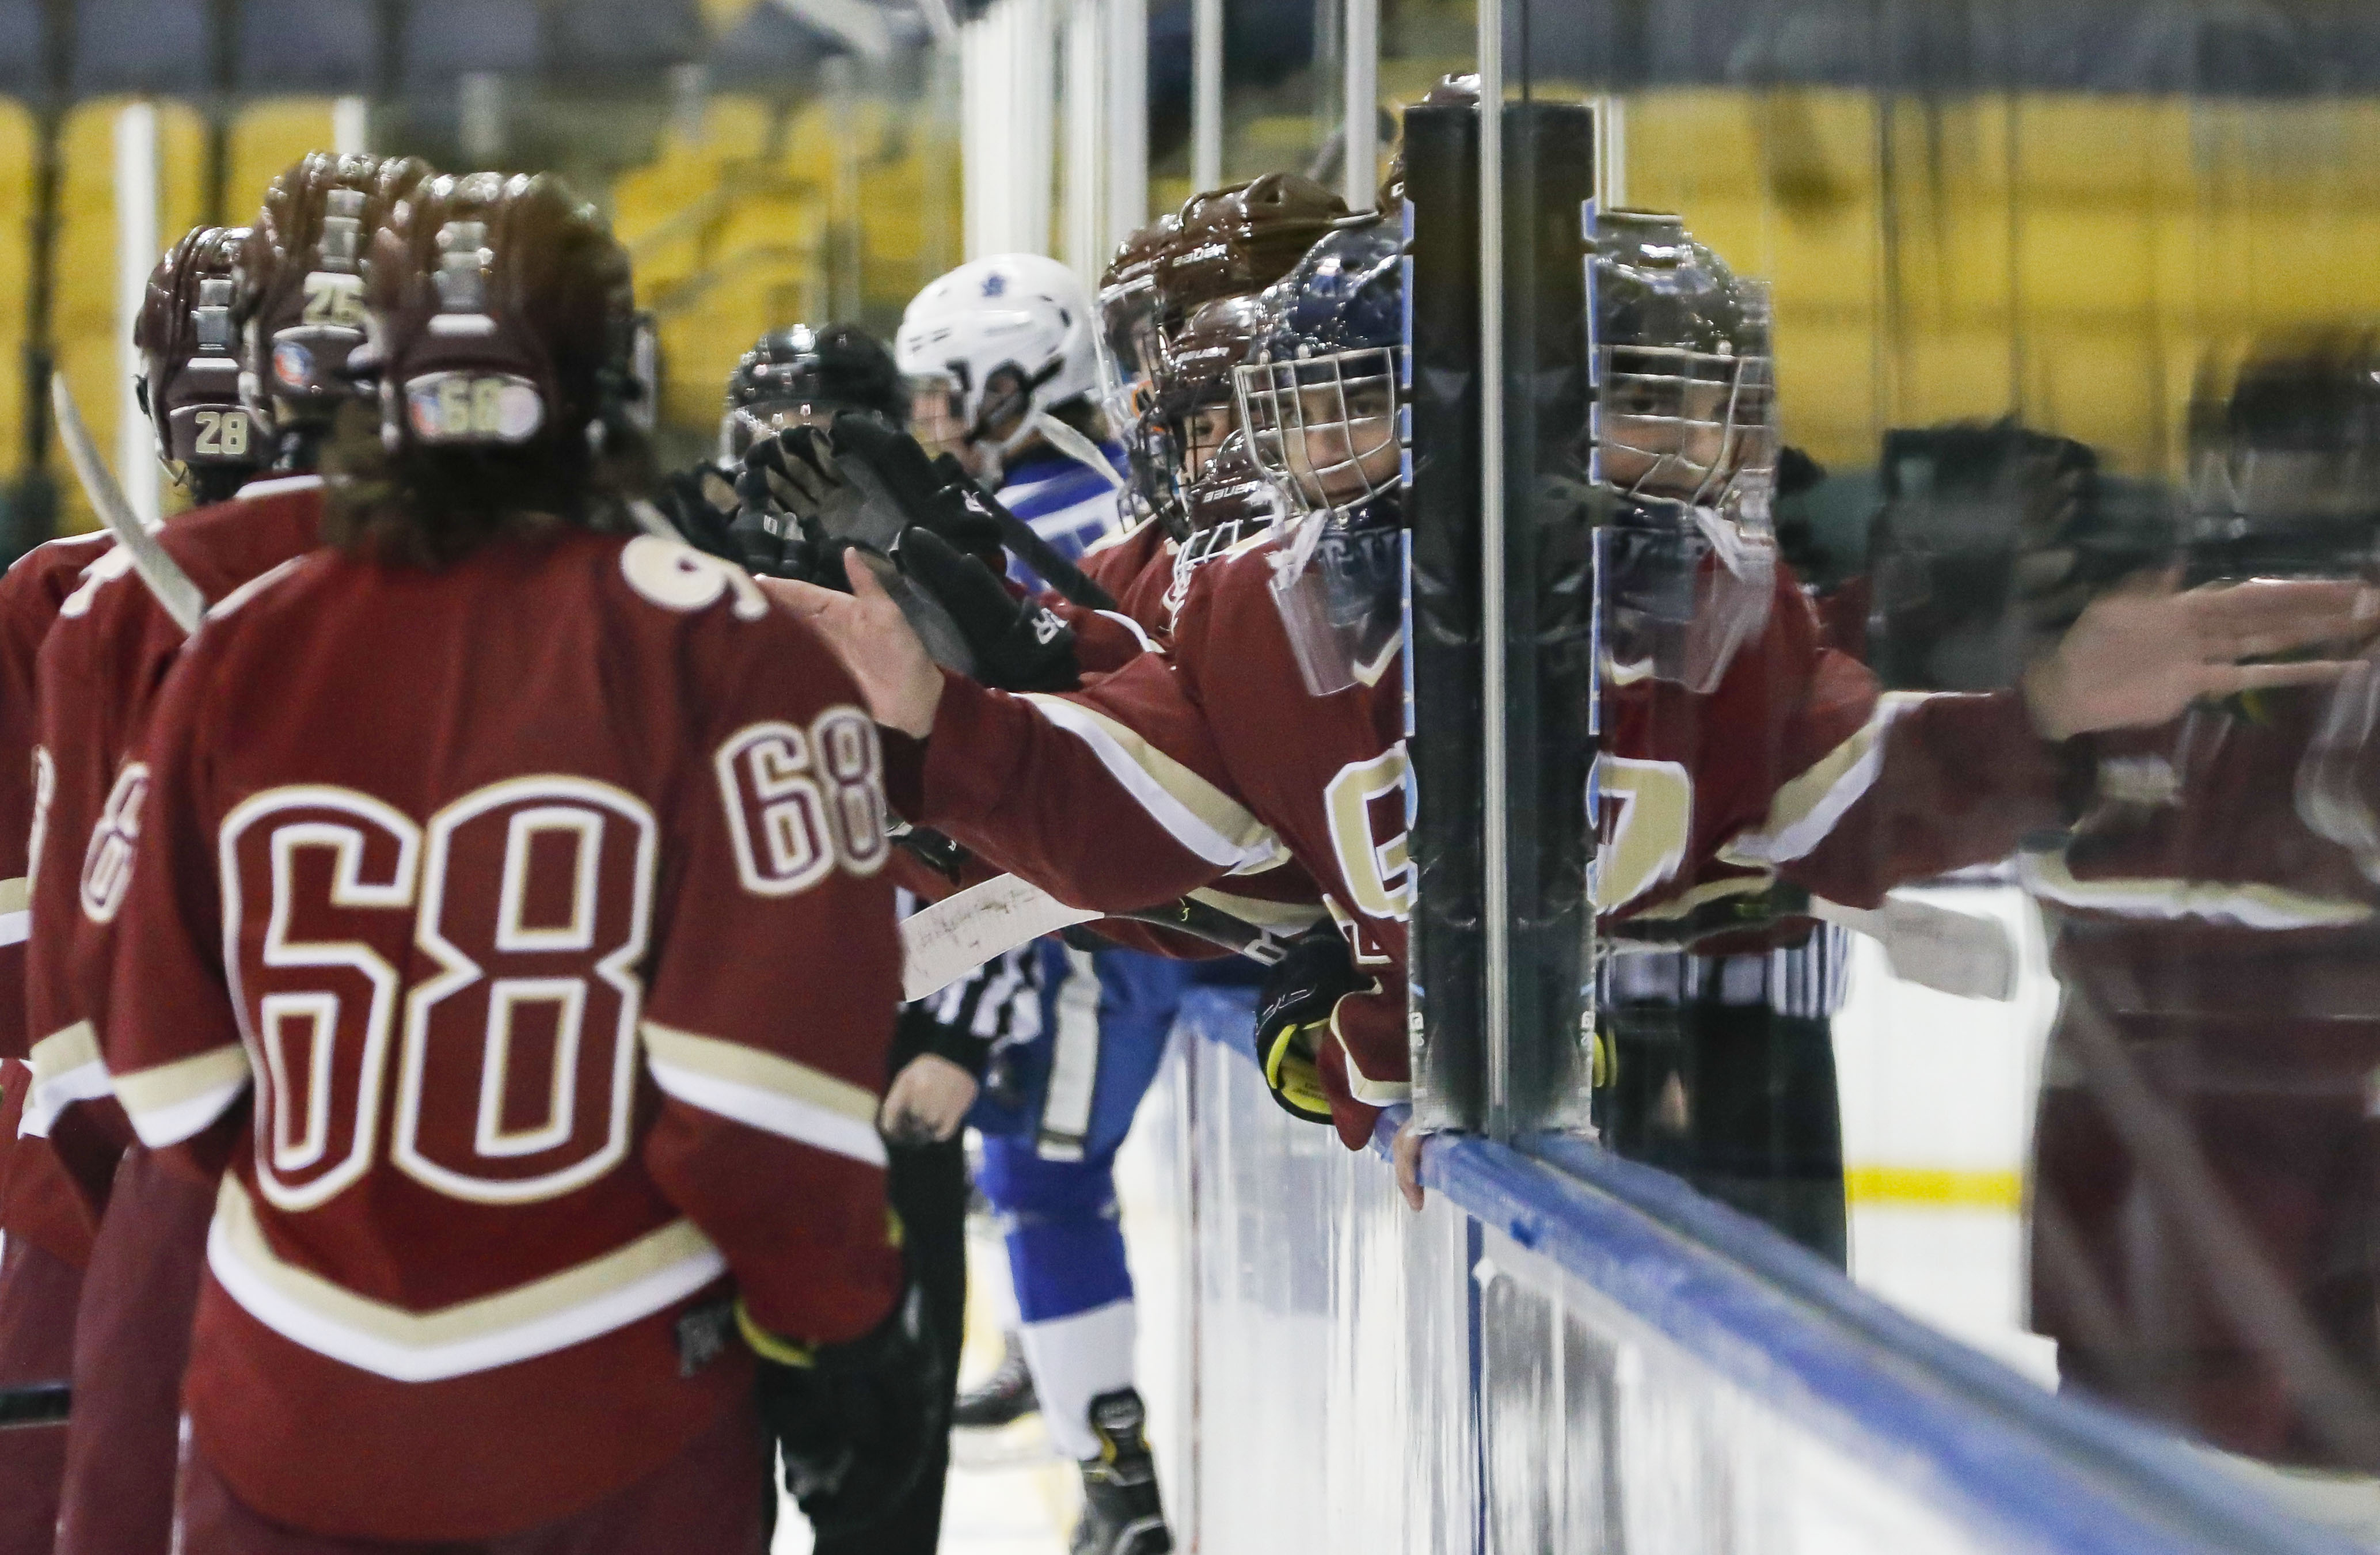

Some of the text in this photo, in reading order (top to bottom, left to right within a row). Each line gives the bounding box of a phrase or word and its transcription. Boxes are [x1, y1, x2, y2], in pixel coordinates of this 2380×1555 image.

[195, 411, 248, 454] 28
[1203, 480, 1259, 503] BAUER
[716, 704, 889, 897] 68
[219, 774, 658, 1212] 68
